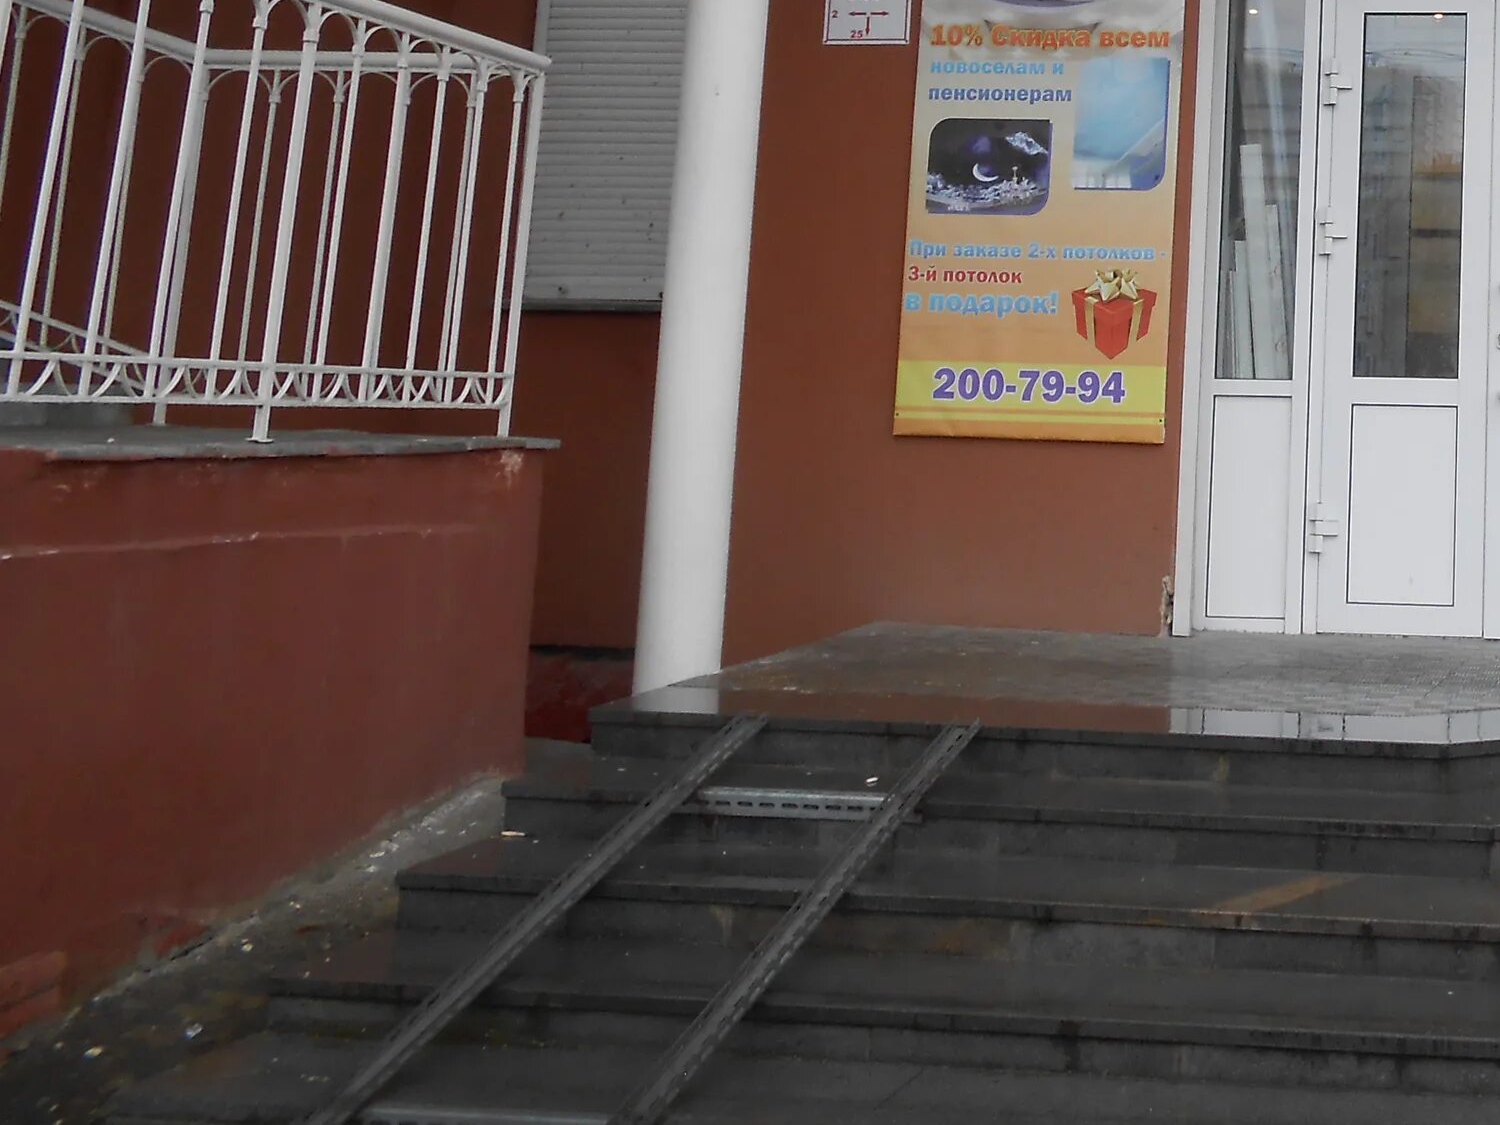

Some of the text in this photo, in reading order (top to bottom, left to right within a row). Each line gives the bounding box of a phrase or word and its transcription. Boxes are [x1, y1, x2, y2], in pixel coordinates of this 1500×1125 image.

[930, 25, 1171, 50] 10% Скидка всем
[930, 61, 1064, 75] новоселам и
[928, 87, 1073, 105] пенсионерам
[909, 239, 947, 259] При
[952, 242, 1022, 259] заказе
[1028, 242, 1057, 259] 2-х
[1062, 245, 1156, 261] потолков
[908, 265, 1023, 284] 3-й потолок
[904, 291, 1060, 317] в подарок!
[931, 367, 1127, 405] 200-79-94
